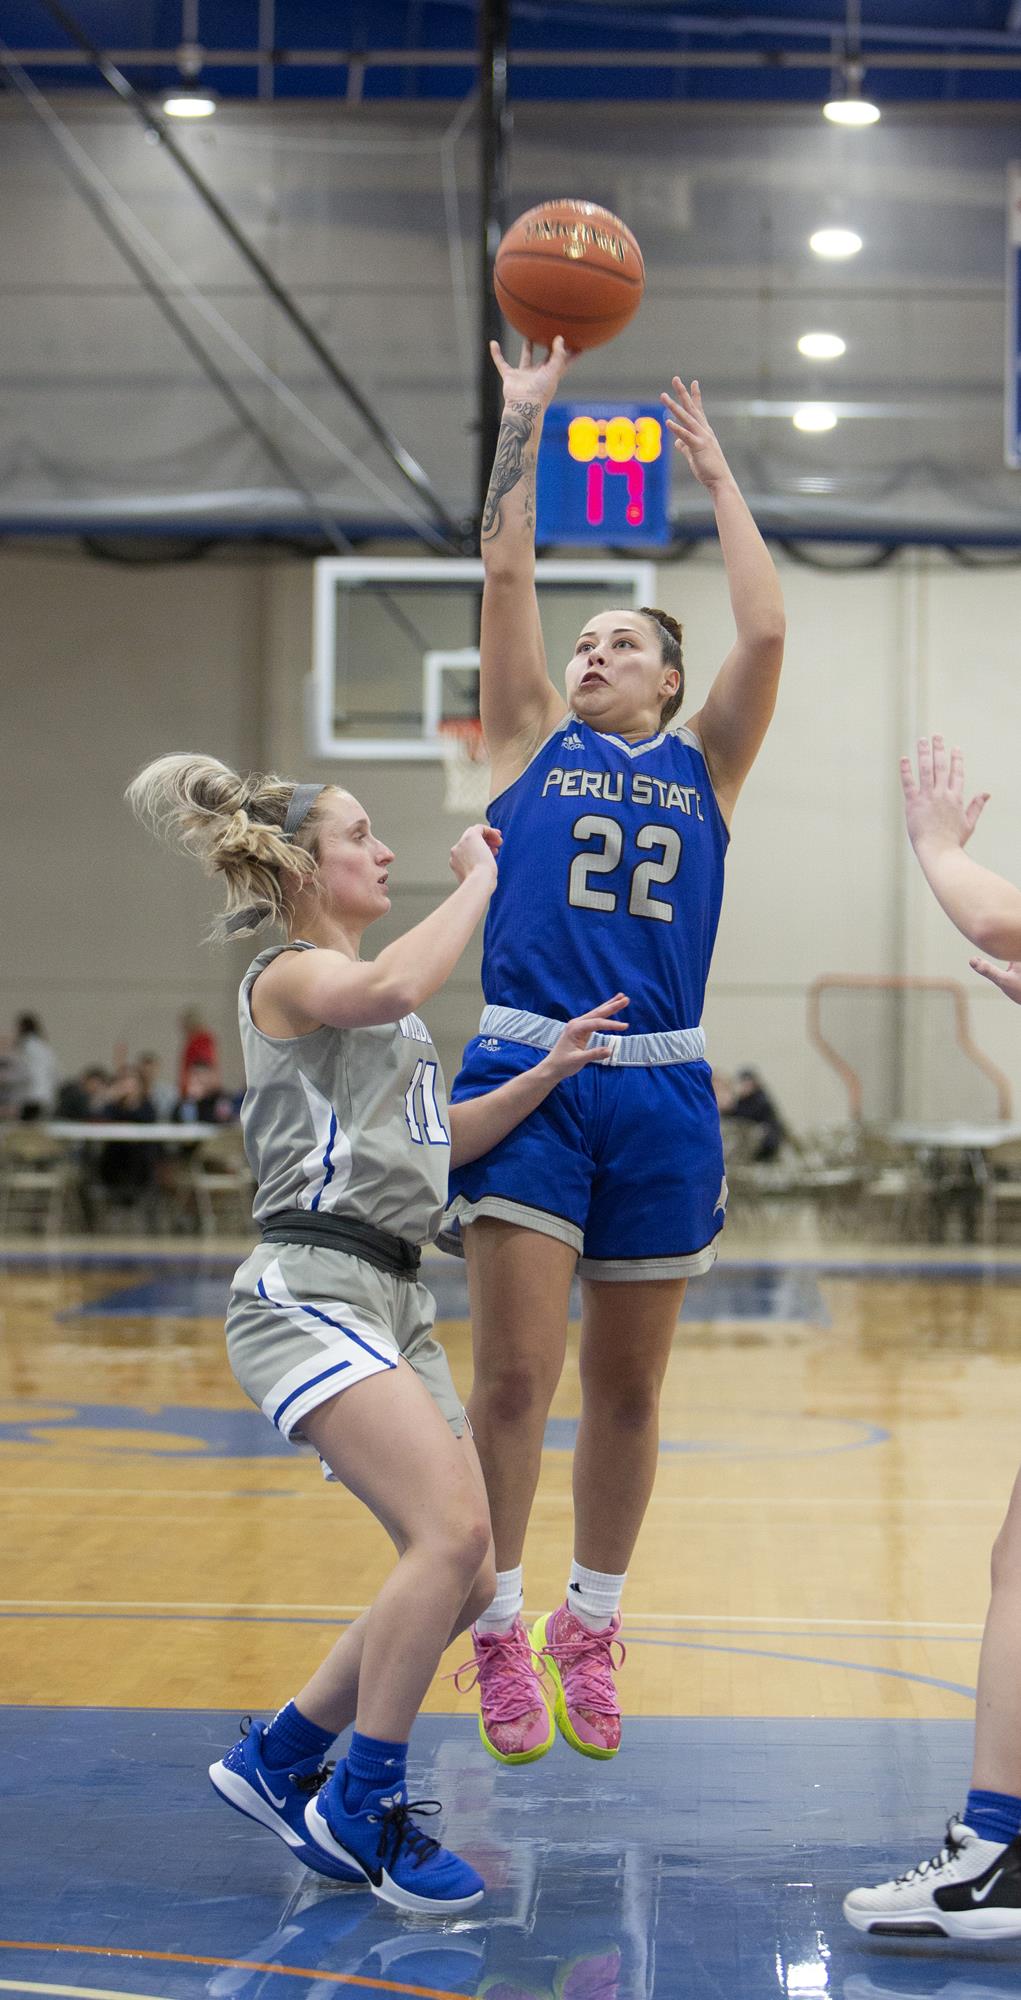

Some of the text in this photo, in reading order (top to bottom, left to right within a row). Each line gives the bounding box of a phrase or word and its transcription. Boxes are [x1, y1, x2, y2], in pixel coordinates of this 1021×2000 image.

[568, 416, 661, 463] 8:03
[587, 459, 645, 527] 17
[541, 768, 625, 802] PERU
[568, 814, 682, 924] 22
[405, 1057, 450, 1146] 11
